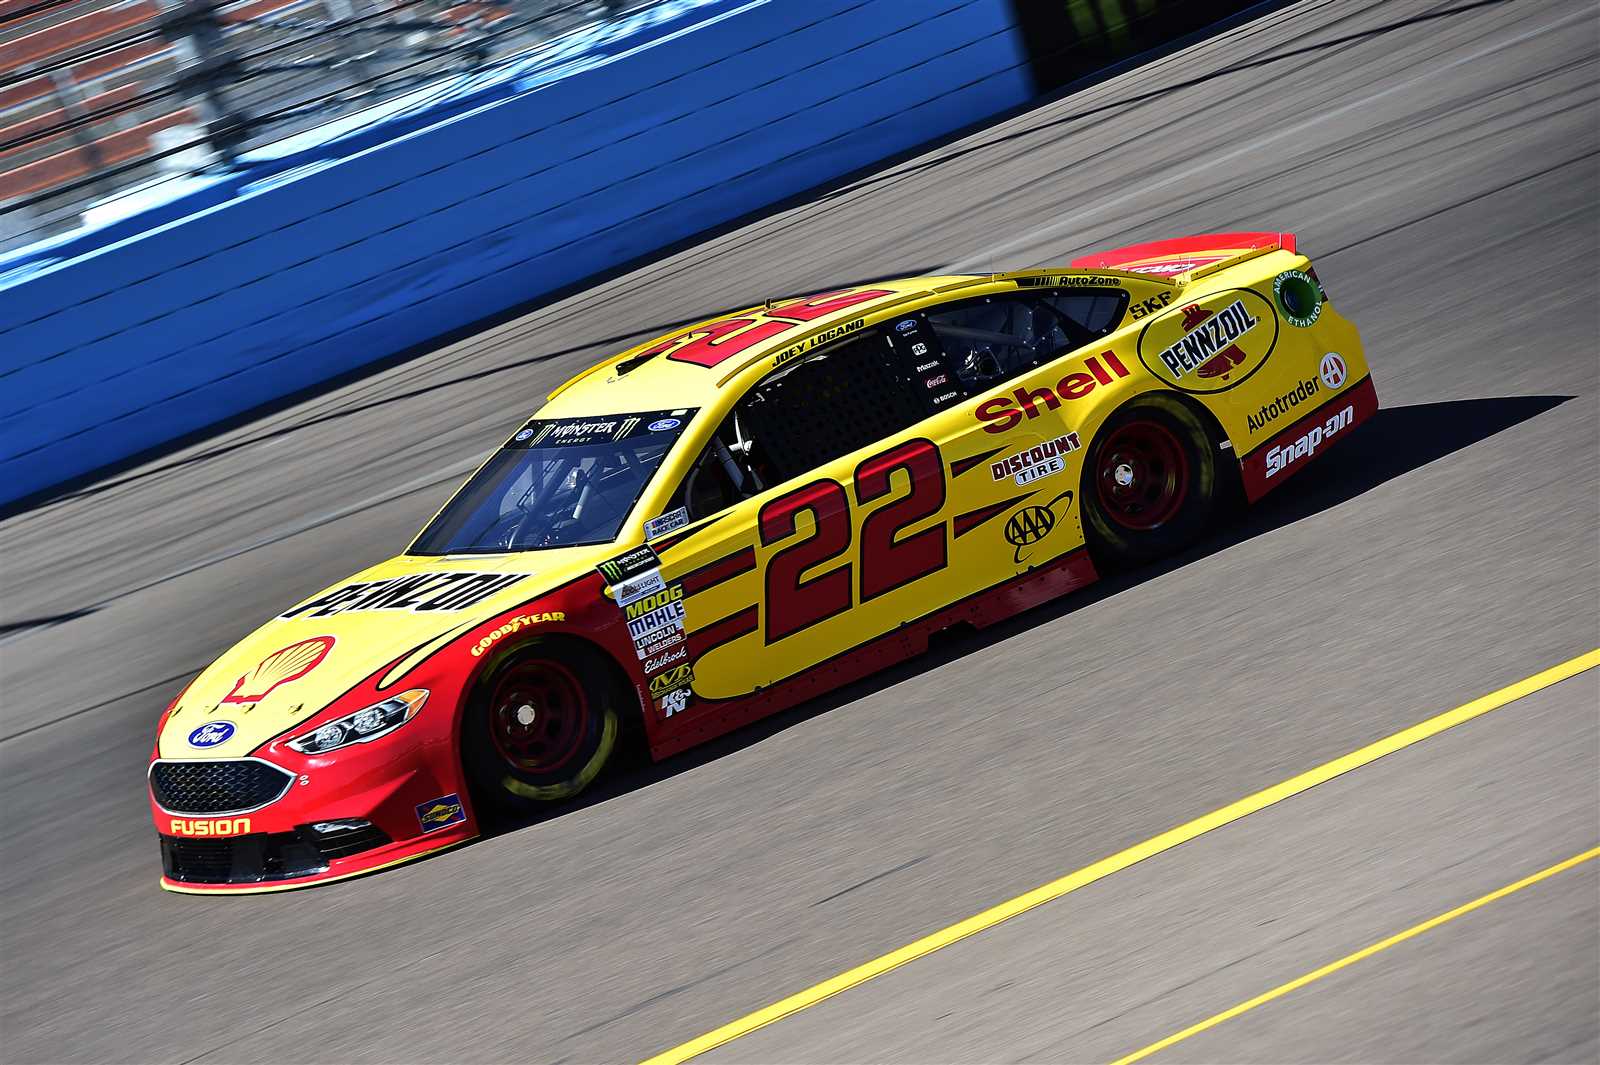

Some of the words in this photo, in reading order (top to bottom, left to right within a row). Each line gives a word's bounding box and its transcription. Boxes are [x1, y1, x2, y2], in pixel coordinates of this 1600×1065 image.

[1059, 276, 1121, 288] AutoZone
[1274, 270, 1311, 294] AMERICAN
[1129, 291, 1173, 321] SKF
[1288, 300, 1322, 327] ETHANOL
[772, 340, 811, 368] JOEY
[810, 319, 865, 347] LOGANO
[1158, 300, 1258, 380] PENNZOIL
[975, 350, 1130, 434] Shell
[1246, 375, 1320, 435] Autotrader
[555, 437, 592, 445] ENERGY
[991, 432, 1081, 481] DISCOUNT
[1018, 460, 1060, 485] TIRE
[669, 518, 685, 529] CAR
[1010, 508, 1050, 545] AAA
[758, 437, 948, 647] 22
[626, 584, 683, 620] MOOG
[470, 611, 566, 657] GOODYEAR
[630, 603, 685, 637] MAHLE
[636, 625, 676, 650] LINCOLN
[646, 634, 682, 654] WELDERS
[645, 646, 687, 674] Edelbrock
[190, 722, 233, 746] Ford
[171, 818, 251, 836] FUSION
